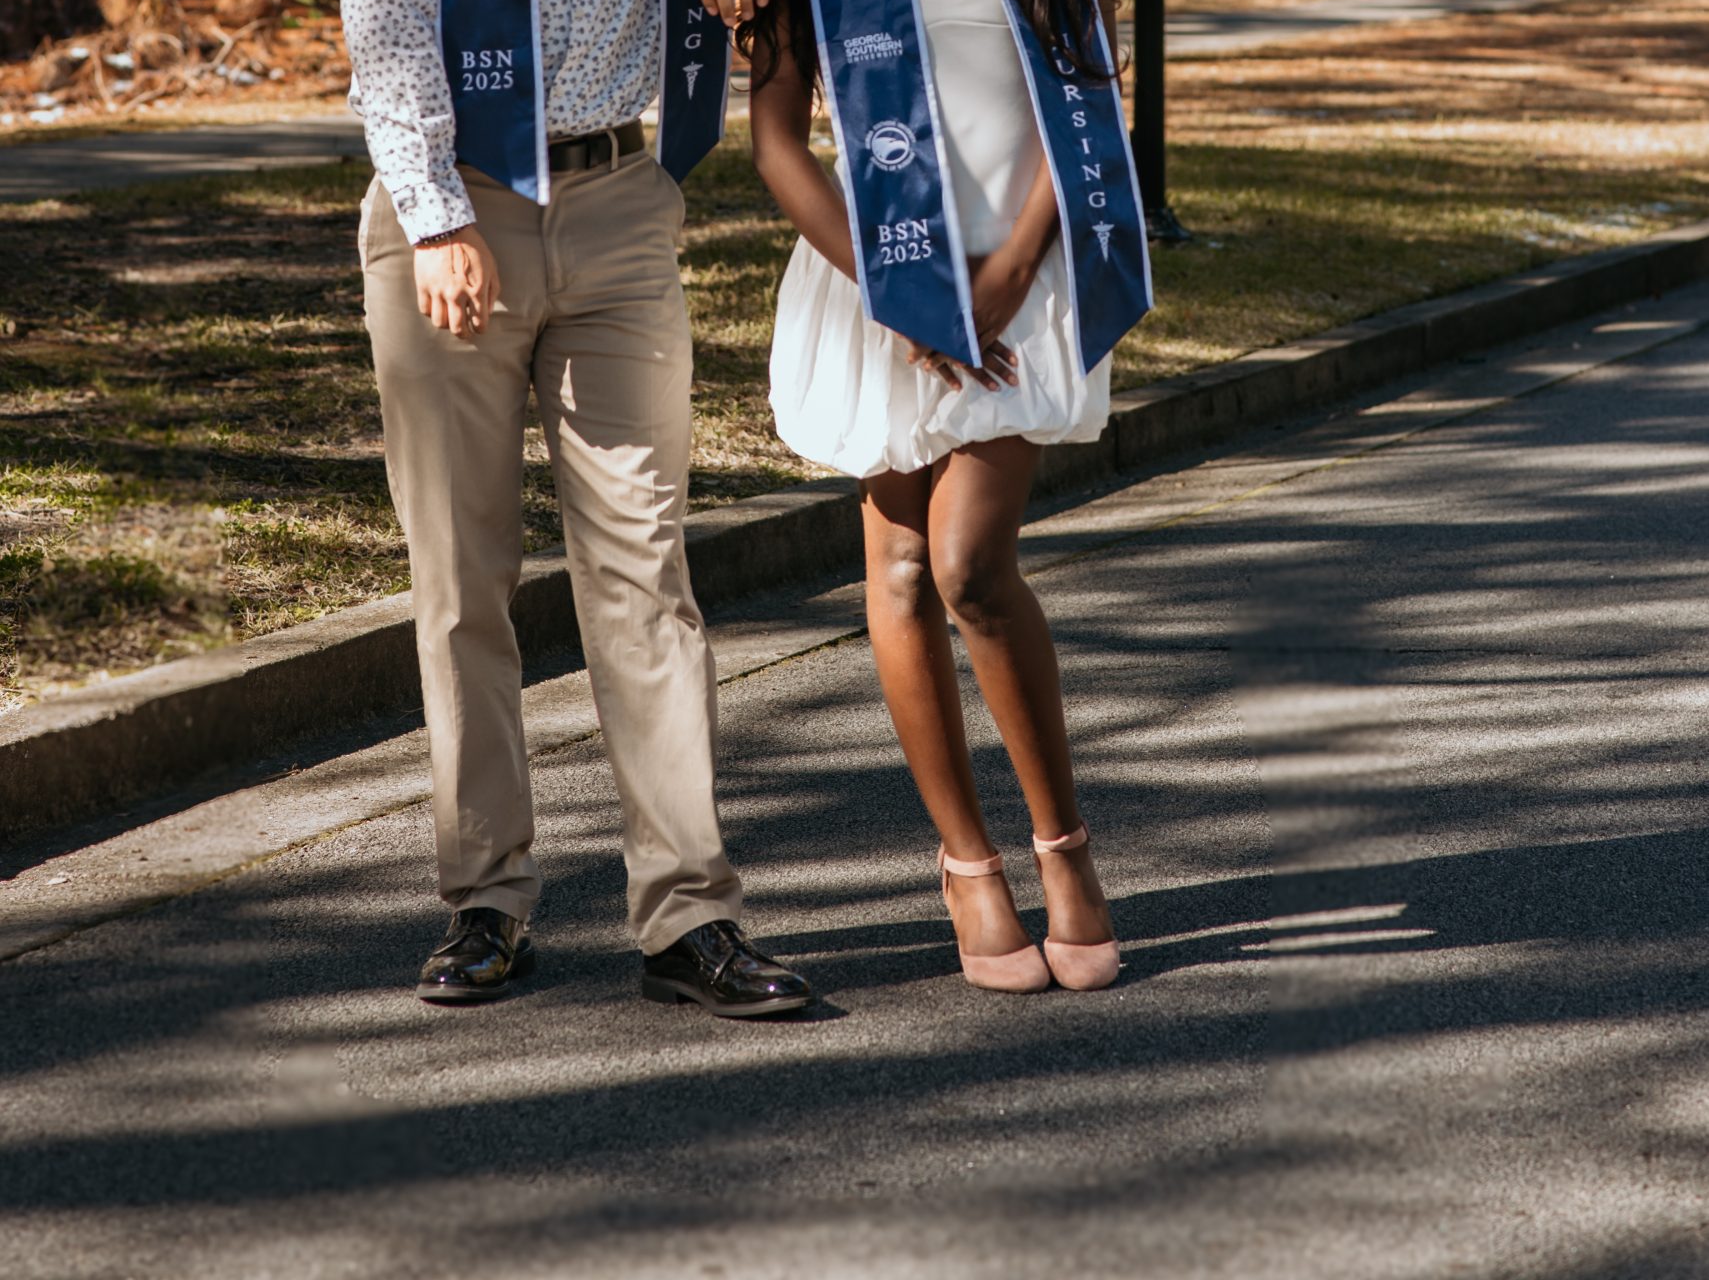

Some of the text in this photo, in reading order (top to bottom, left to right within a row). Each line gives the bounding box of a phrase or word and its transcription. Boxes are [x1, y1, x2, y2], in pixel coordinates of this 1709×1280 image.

[844, 32, 893, 49] GEORGIA
[845, 39, 904, 58] SOUTHERN
[461, 49, 514, 69] BSN
[462, 70, 514, 91] 2025
[877, 219, 930, 244] BSN
[881, 239, 933, 265] 2025
